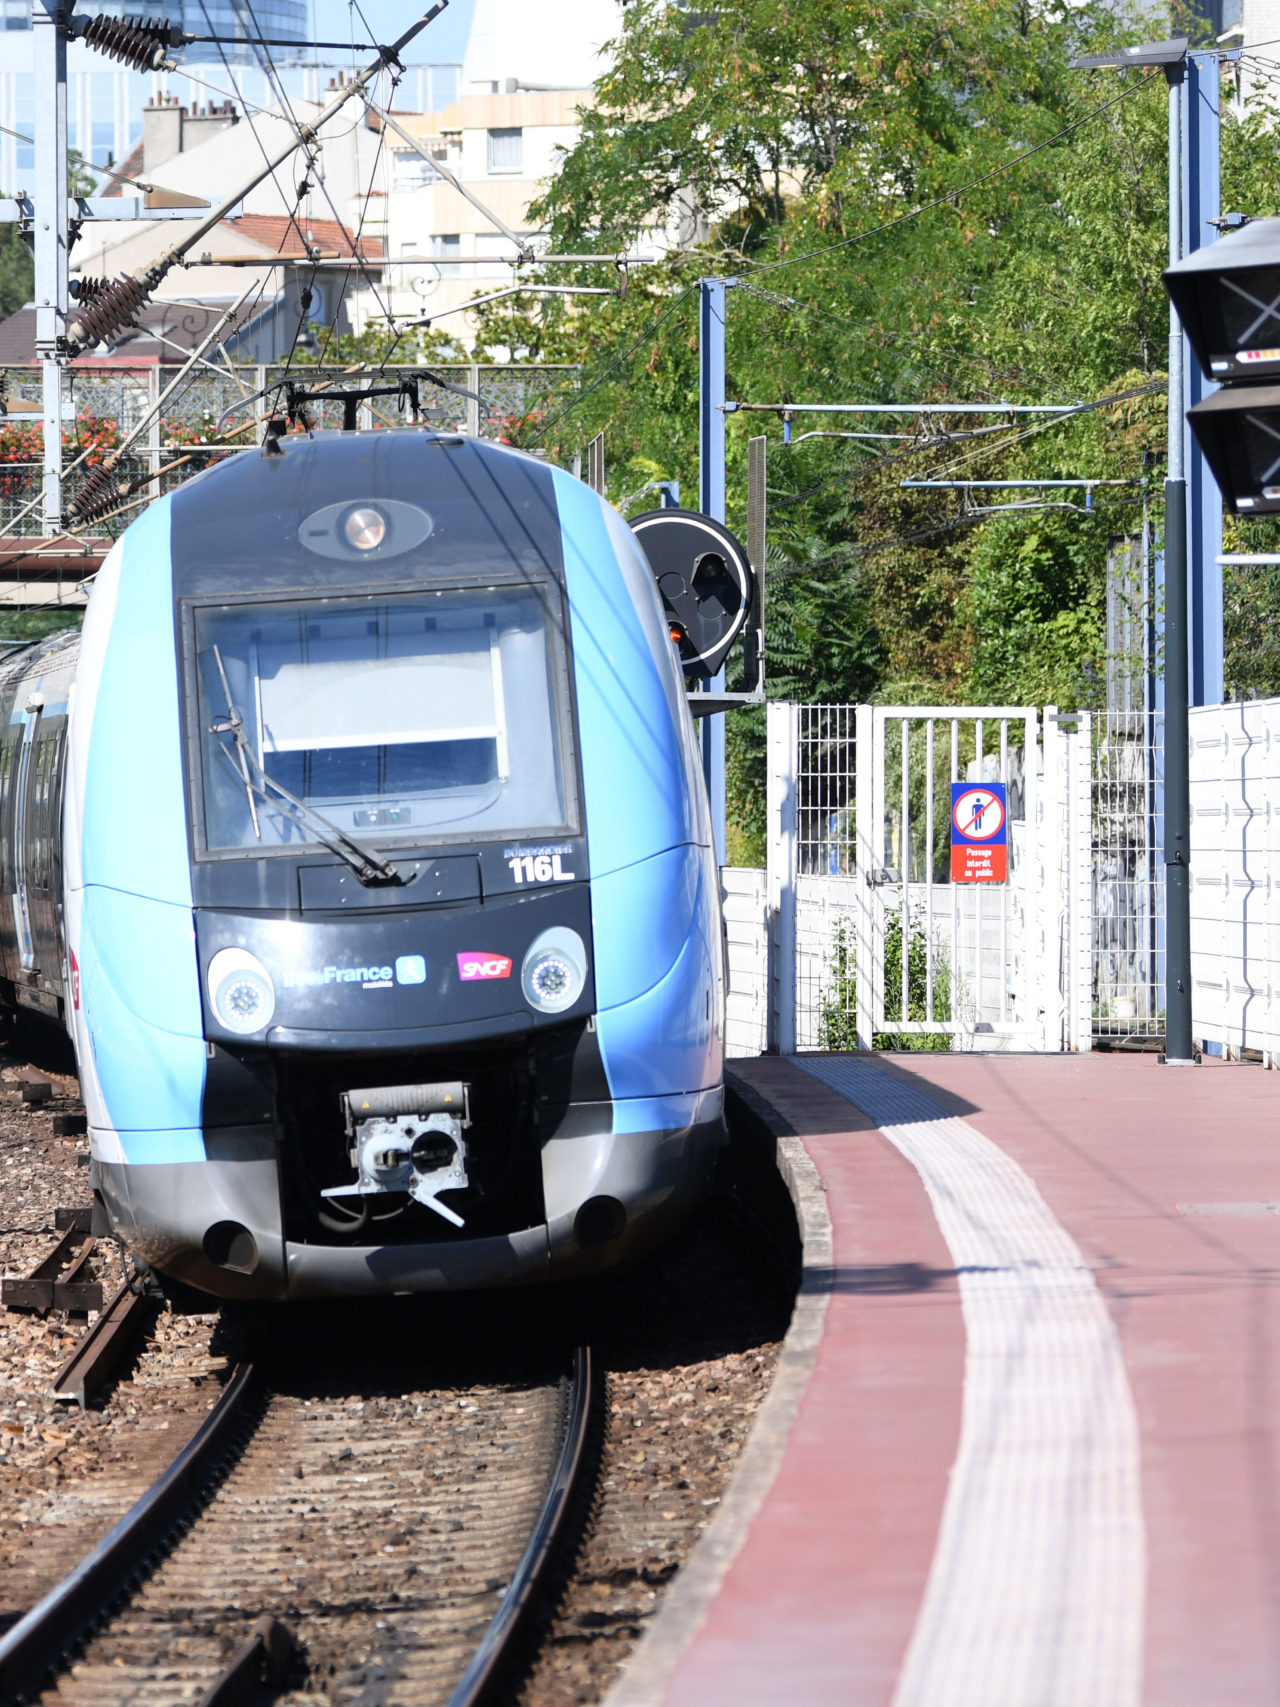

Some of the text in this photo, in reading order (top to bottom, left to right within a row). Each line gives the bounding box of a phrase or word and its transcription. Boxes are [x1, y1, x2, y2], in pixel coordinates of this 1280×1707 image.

[508, 854, 575, 884] 116L
[975, 868, 993, 879] public
[462, 959, 509, 978] SNCF
